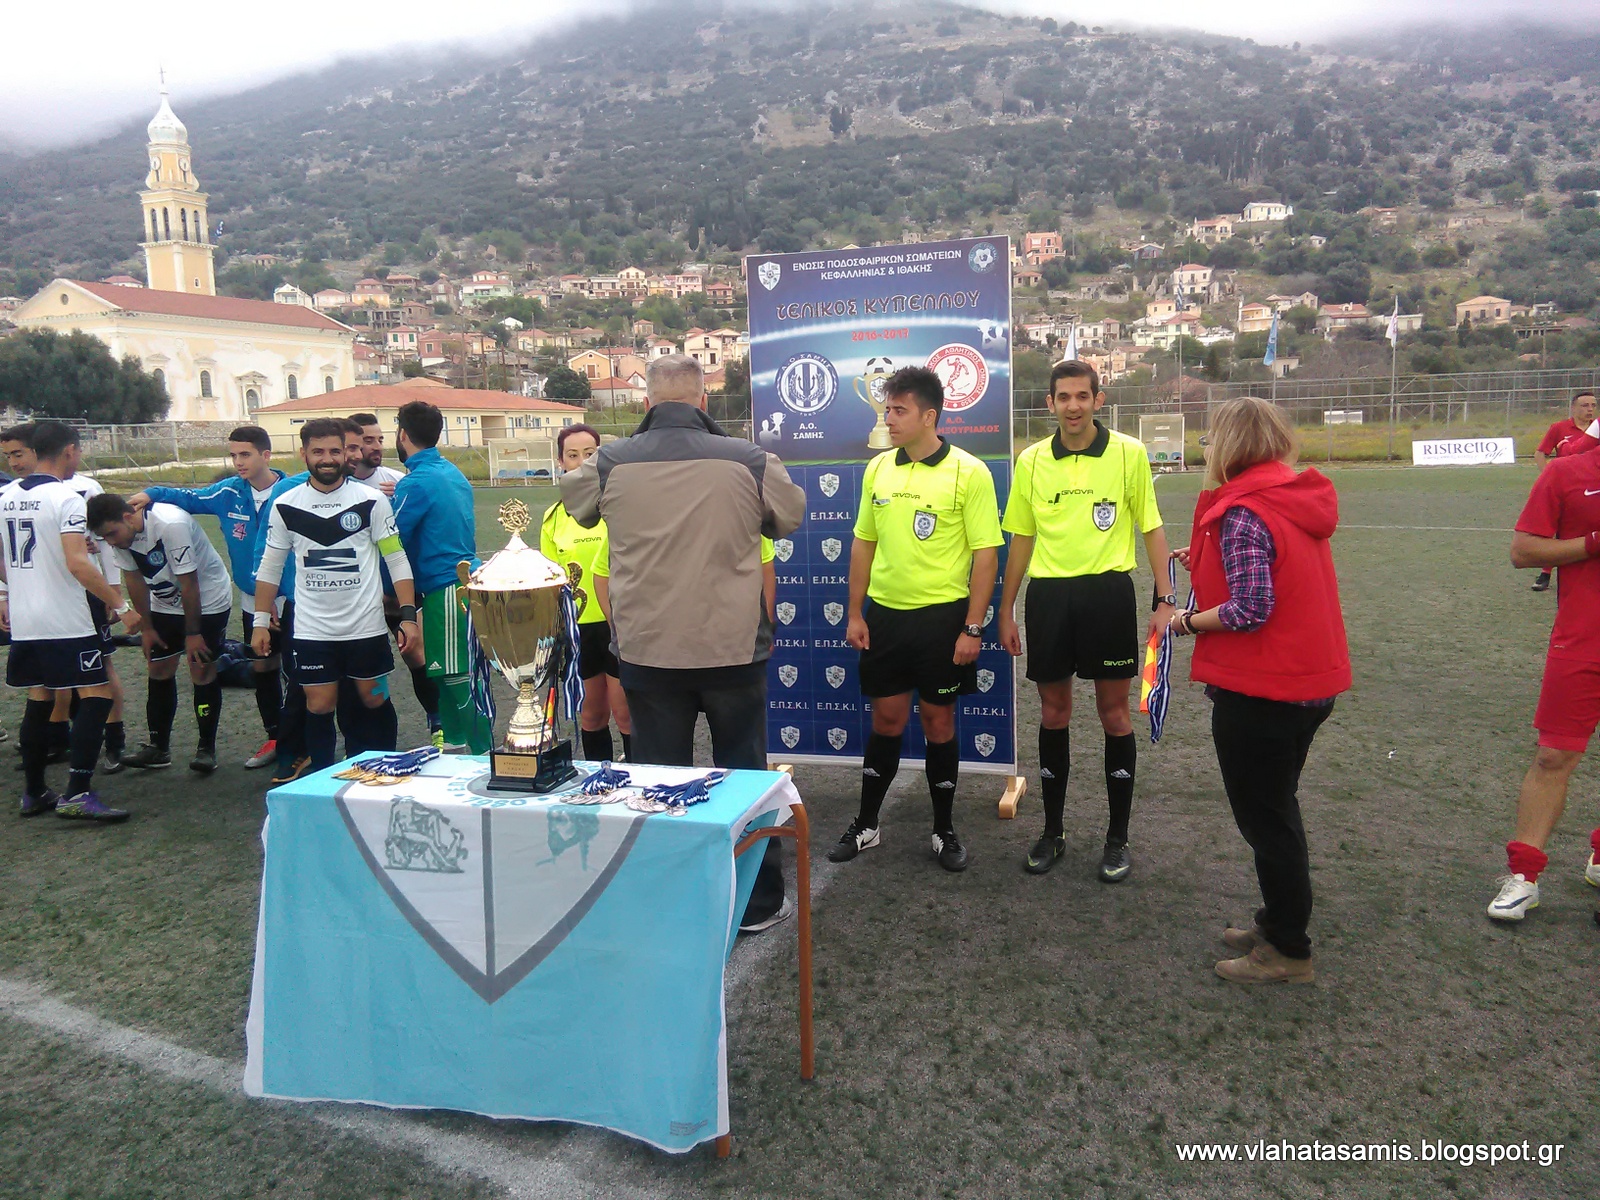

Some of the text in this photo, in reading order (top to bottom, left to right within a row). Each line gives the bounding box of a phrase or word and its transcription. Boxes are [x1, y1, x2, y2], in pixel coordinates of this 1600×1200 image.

[792, 250, 962, 271] ΕΝΩΣΙΣ ΠΟΔΟΣΦΑΙΡΙΚΩΝ ΣΩΜΑΤΕΙΩΝ
[820, 264, 933, 280] ΚΕΦΑΛΛΗΝΙΑΣ & ΙΘΑΚΗΣ
[851, 328, 910, 341] 2016-2017
[799, 422, 817, 430] Α.Ο.
[793, 431, 824, 440] ΣΑΜΗΣ
[810, 511, 852, 520] Ε.Π.Σ.Κ.Ι.
[5, 517, 37, 569] 17
[573, 536, 602, 544] GIVOVA
[305, 577, 361, 588] STEFATOU
[812, 576, 849, 584] Ε.Π.Σ.Κ.
[774, 639, 807, 647] .Π.Σ.Κ.Ι.
[1103, 658, 1134, 667] GIVOVA
[770, 701, 809, 710] Ε.Π.Σ.Κ.Ι.
[817, 702, 857, 711] Ε.Π.Σ.Κ.Ι.
[963, 706, 1007, 716] Ε.Π.Σ.Κ.Ι.
